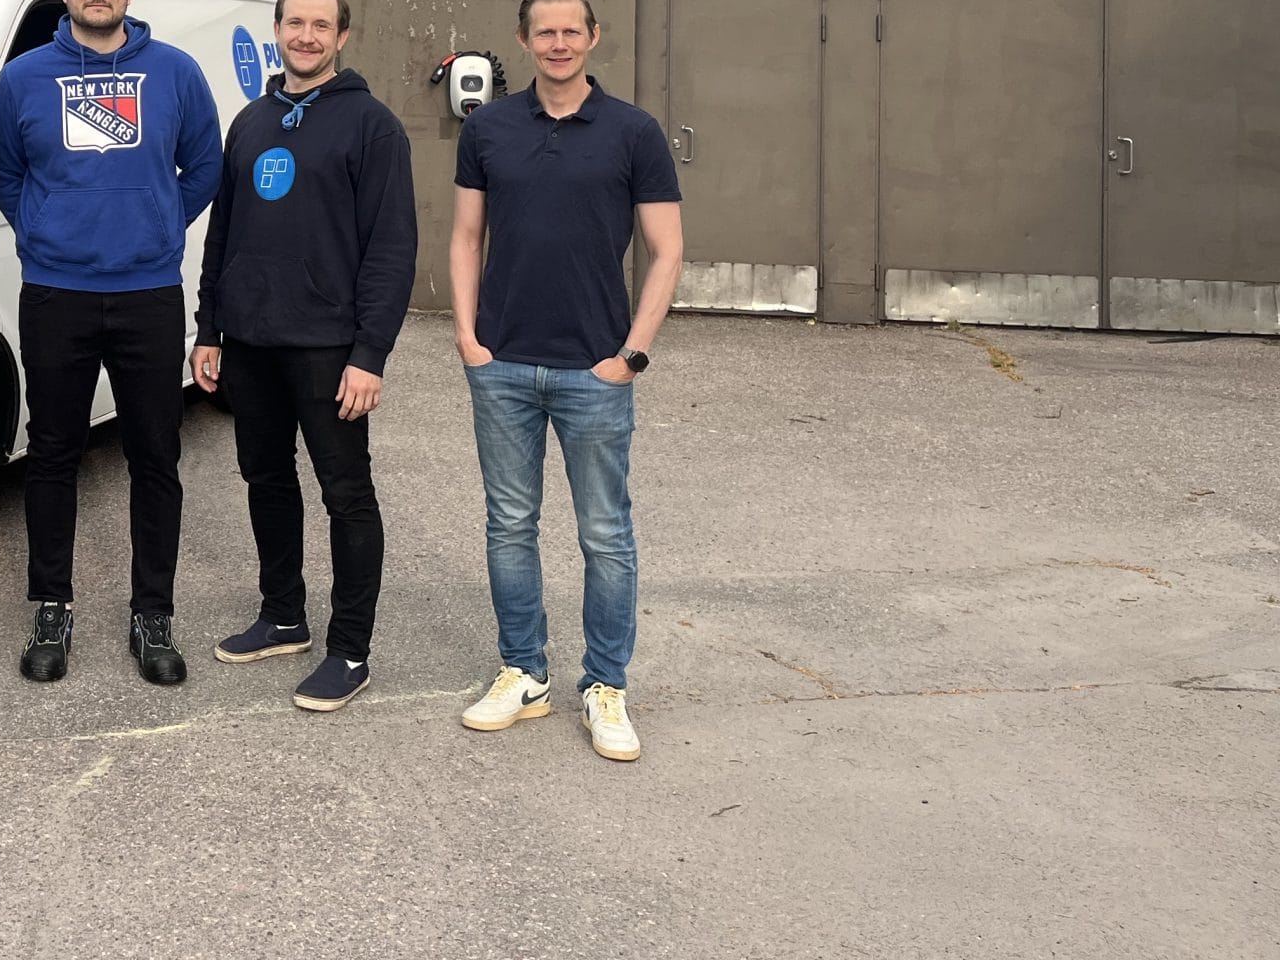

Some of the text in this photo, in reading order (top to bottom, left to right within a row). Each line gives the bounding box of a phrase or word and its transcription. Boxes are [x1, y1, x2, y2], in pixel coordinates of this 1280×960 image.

[262, 42, 282, 69] PU
[66, 81, 136, 98] NEW YORK
[76, 99, 134, 141] RANGERS
